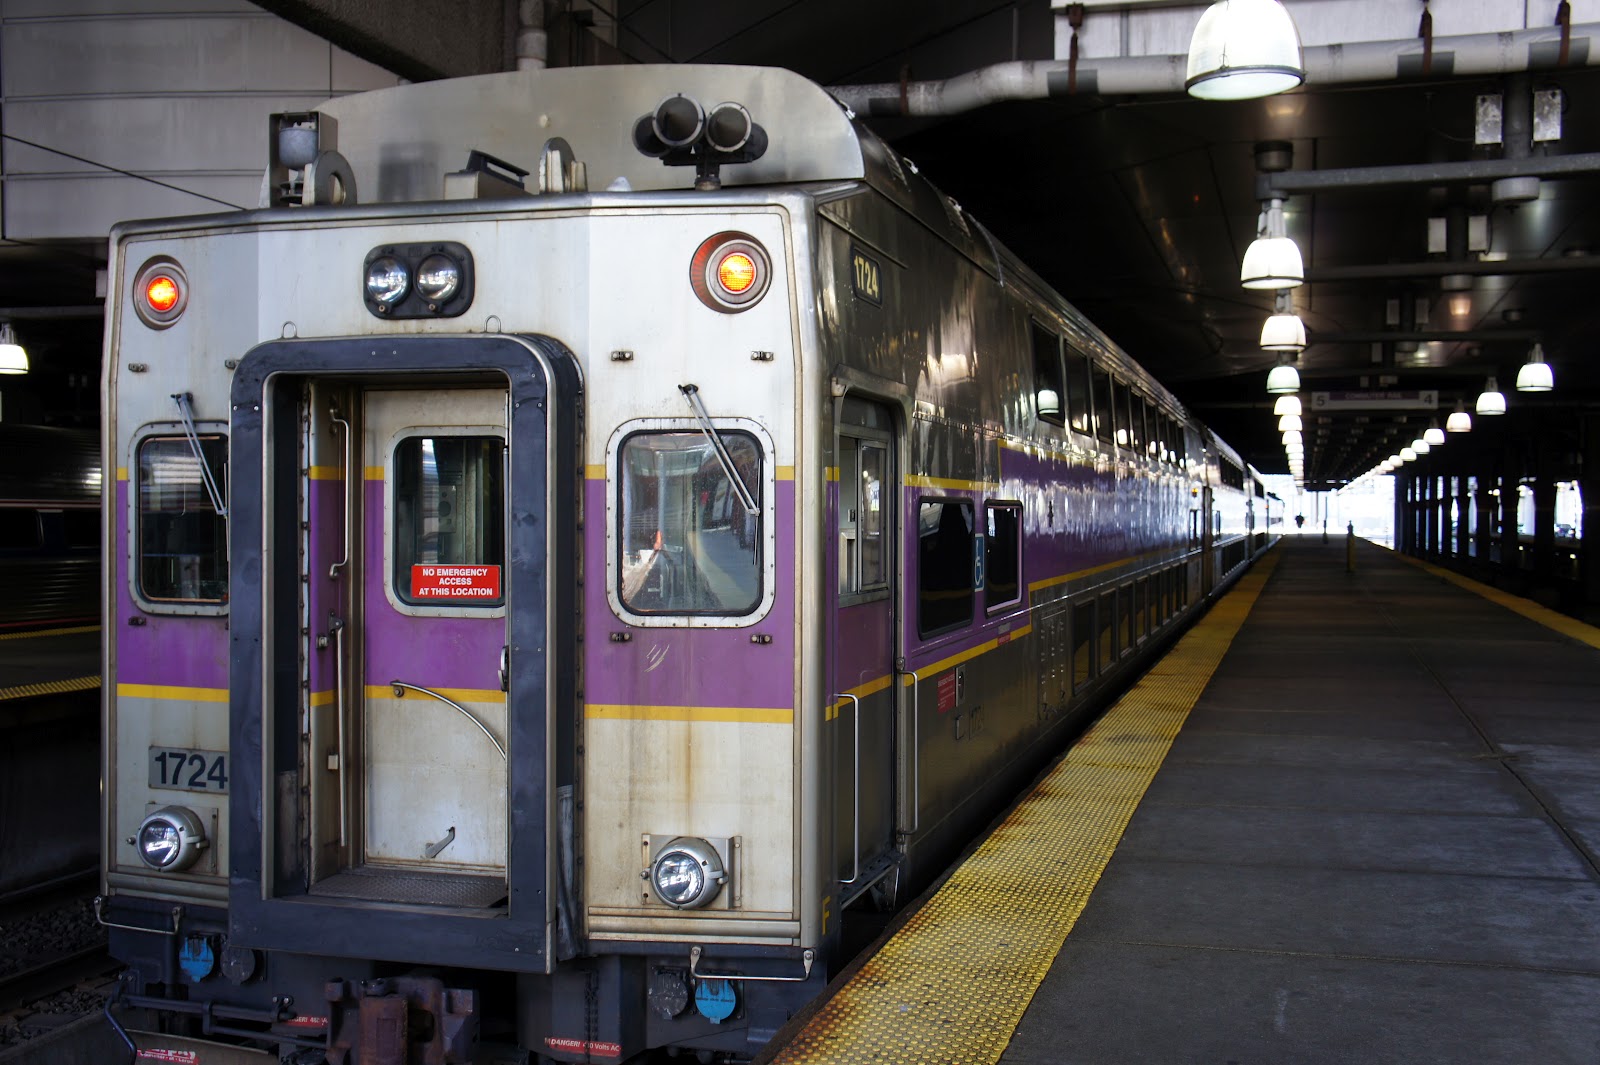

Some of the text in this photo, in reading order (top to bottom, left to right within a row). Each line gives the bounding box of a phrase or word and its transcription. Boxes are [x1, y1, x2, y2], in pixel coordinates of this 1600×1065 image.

[854, 255, 878, 298] 1724
[1316, 395, 1325, 407] 5
[1424, 394, 1432, 405] 4
[422, 568, 488, 576] NO EMERGENCY
[439, 577, 472, 585] ACCESS
[451, 588, 493, 596] LOCATION
[154, 751, 228, 789] 1724
[551, 1038, 581, 1047] DANGER!
[582, 1041, 594, 1049] 40
[594, 1042, 609, 1051] Volts
[610, 1044, 620, 1052] AC
